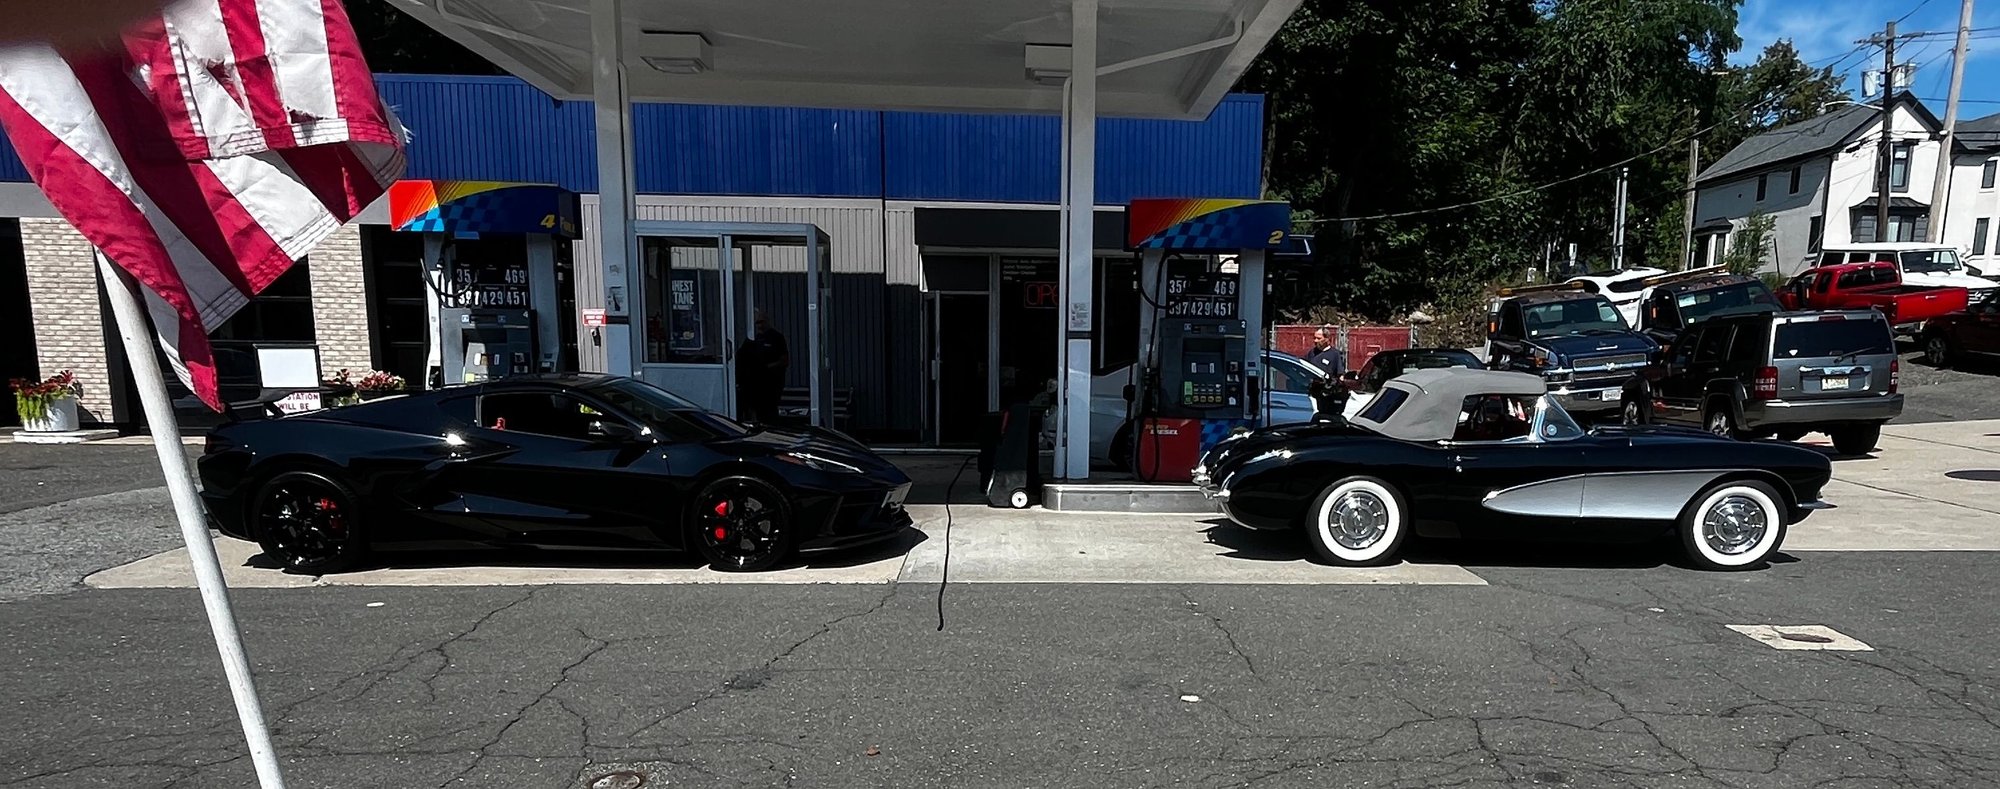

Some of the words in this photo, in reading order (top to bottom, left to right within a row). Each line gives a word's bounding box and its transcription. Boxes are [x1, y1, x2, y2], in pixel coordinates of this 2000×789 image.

[540, 213, 556, 229] 4
[1268, 230, 1284, 245] 2
[505, 268, 526, 284] 469
[1214, 280, 1235, 296] 469
[482, 291, 504, 305] 429
[506, 291, 527, 306] 451
[1190, 301, 1211, 316] 429
[1213, 301, 1232, 316] 451
[278, 402, 297, 411] WILL
[299, 402, 310, 410] BE
